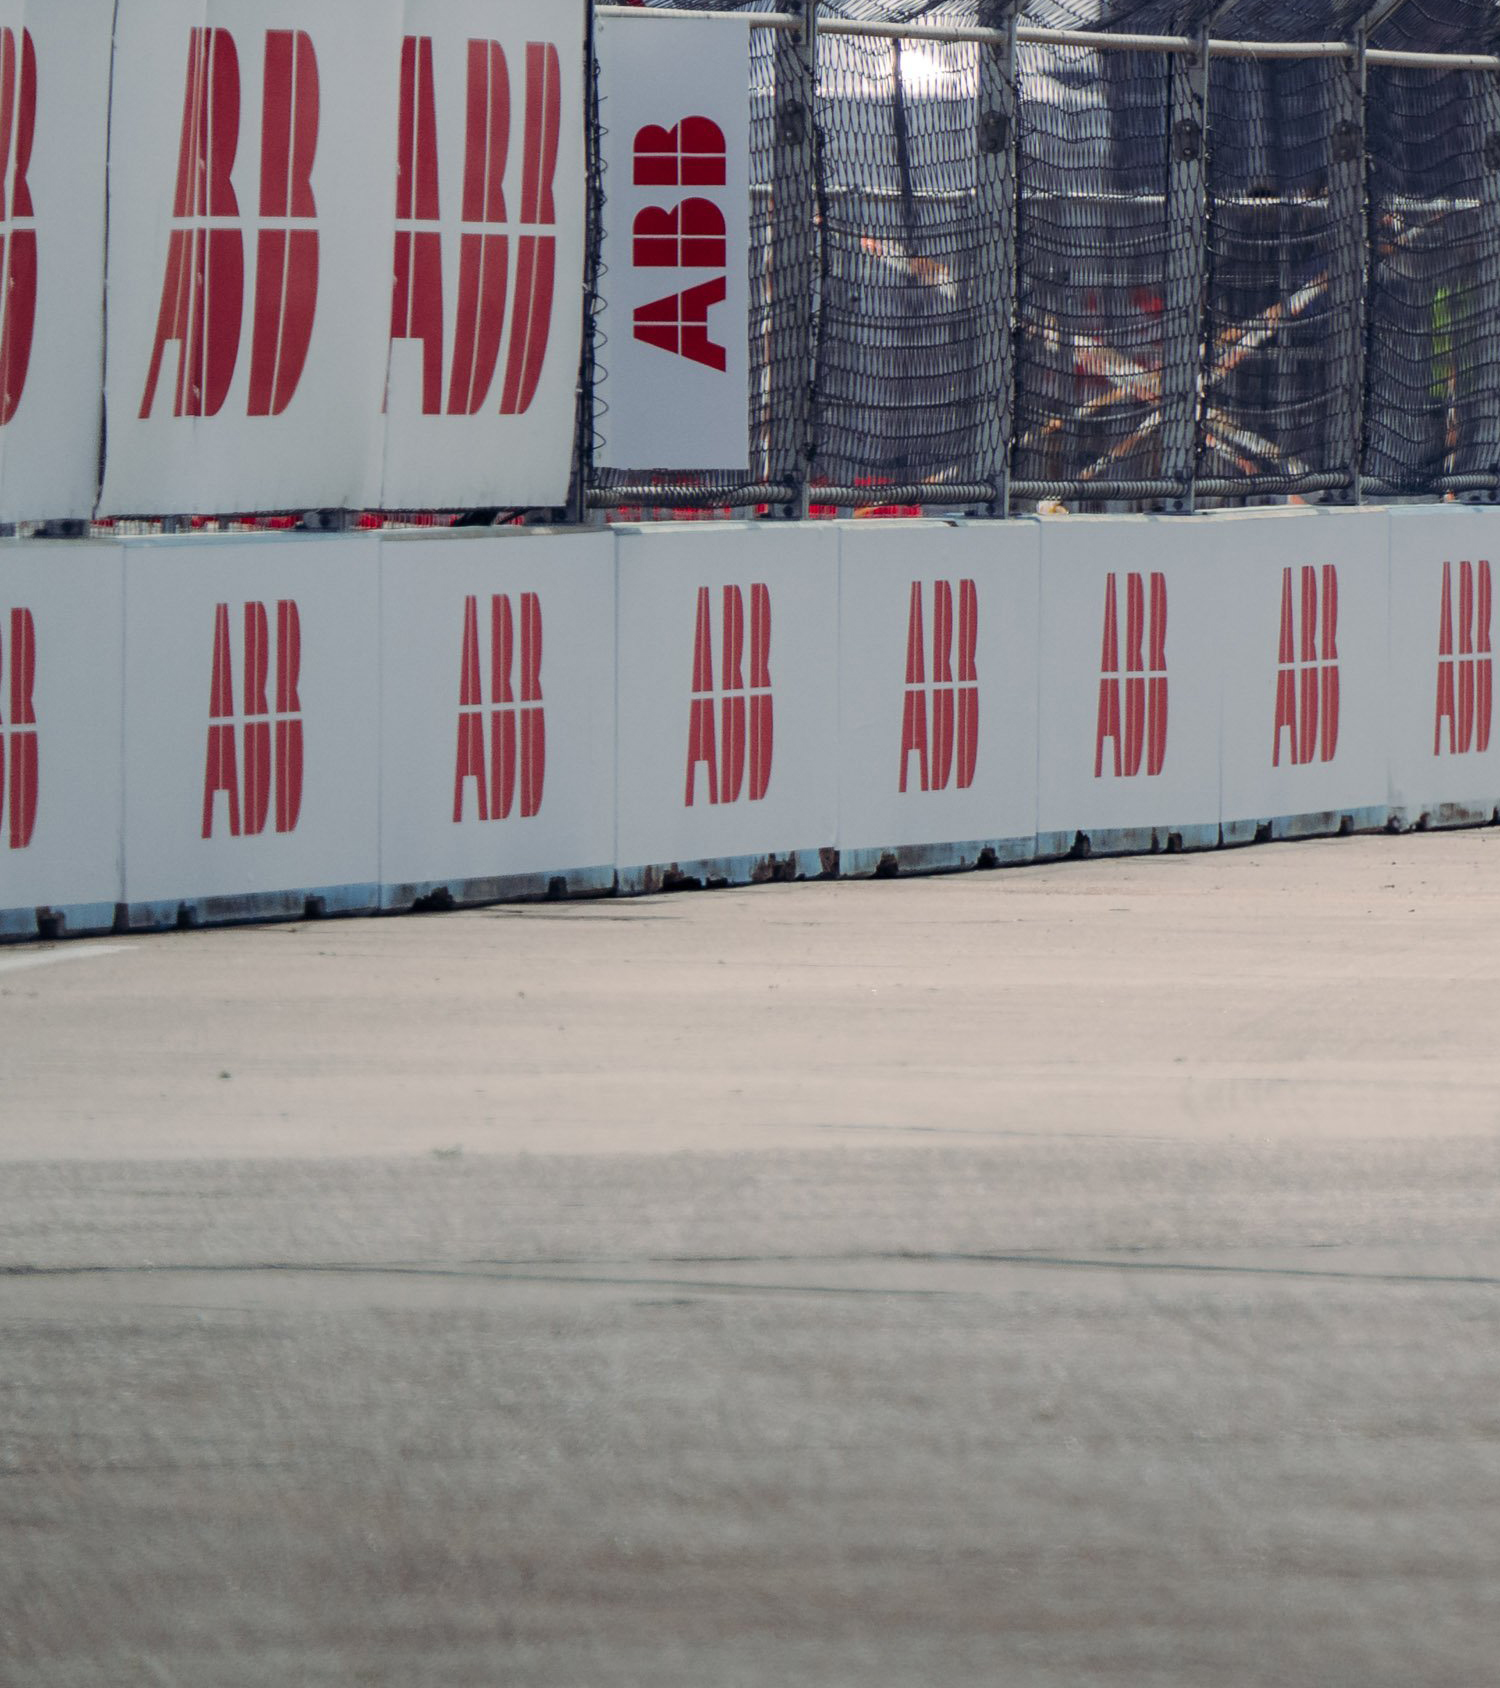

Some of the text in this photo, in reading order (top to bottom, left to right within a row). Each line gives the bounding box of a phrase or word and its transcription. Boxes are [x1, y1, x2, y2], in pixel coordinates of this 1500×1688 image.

[633, 115, 727, 372] ABB
[202, 598, 304, 839] ABB
[453, 592, 546, 824] ABB
[685, 583, 774, 808] ABB
[898, 578, 979, 793] ABB
[1094, 571, 1168, 778] ABB
[1273, 564, 1340, 768] ABB
[1434, 559, 1493, 756] ABB
